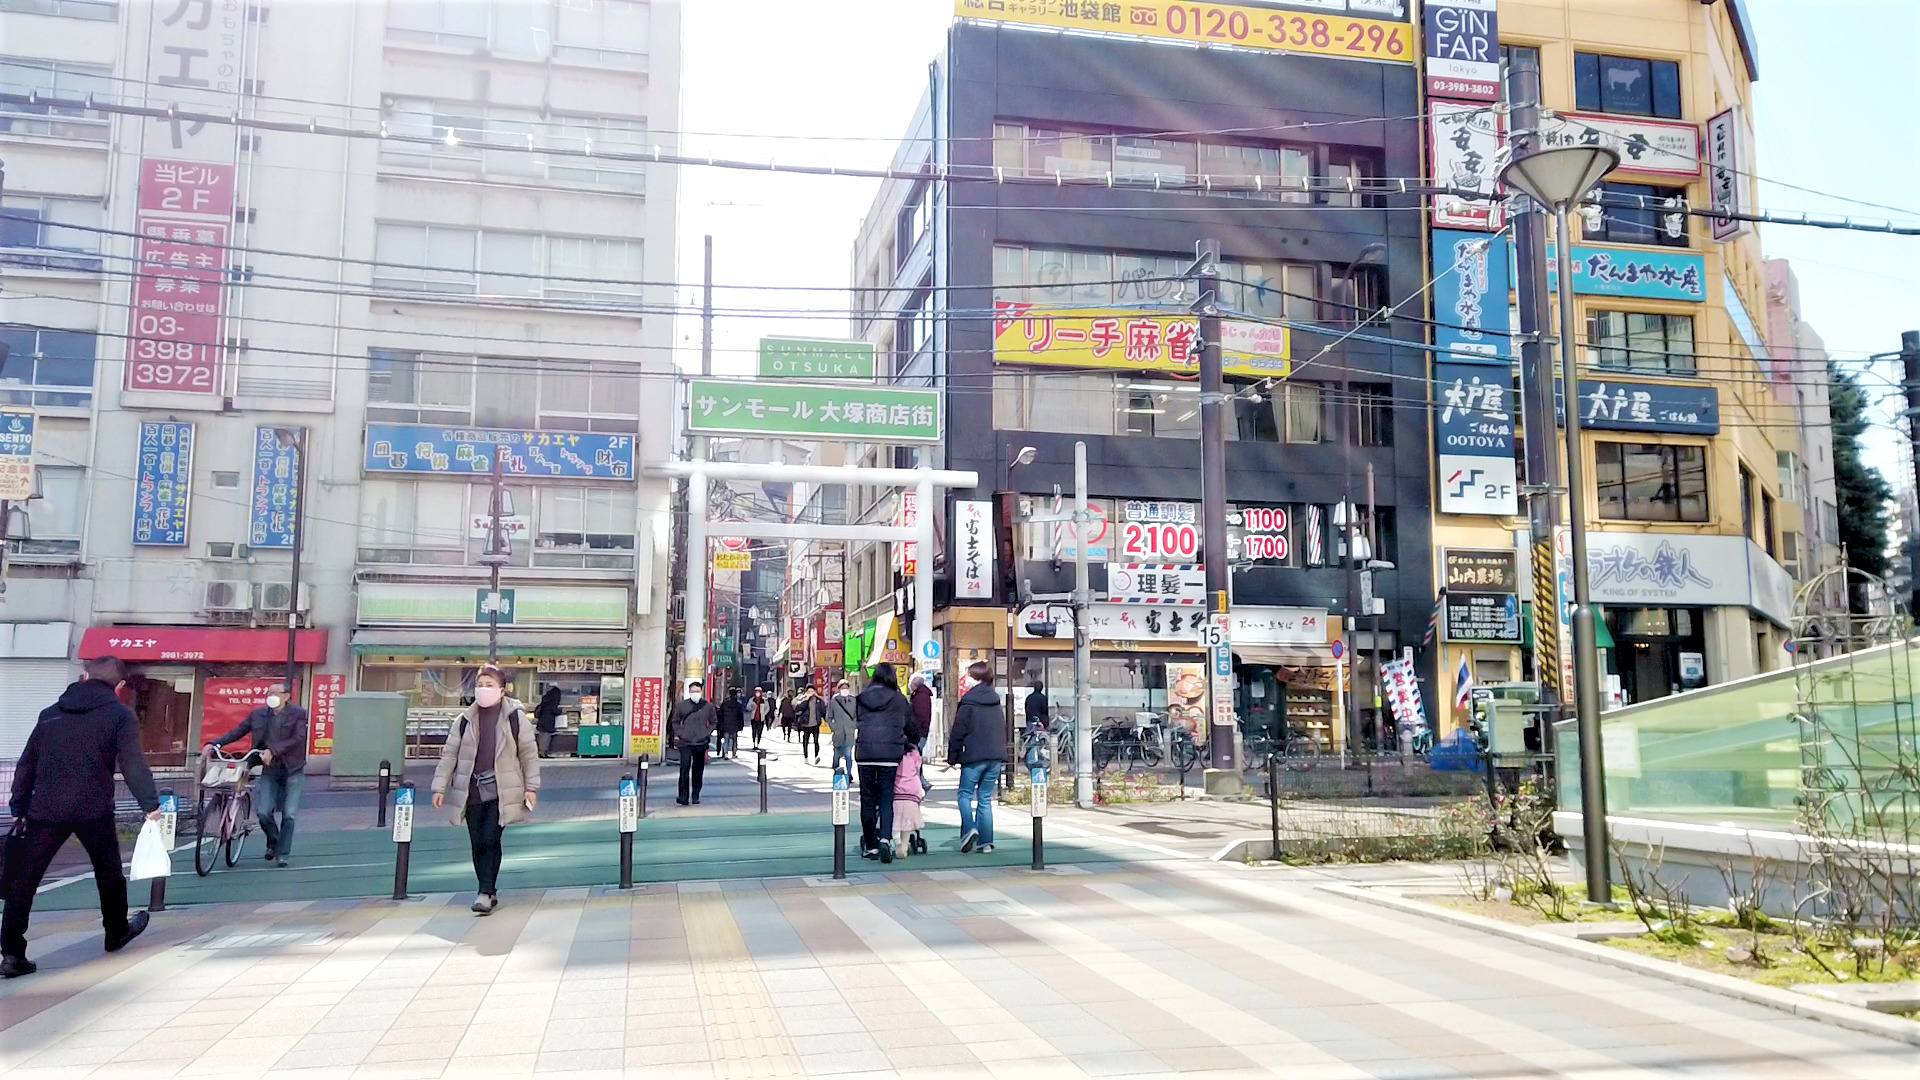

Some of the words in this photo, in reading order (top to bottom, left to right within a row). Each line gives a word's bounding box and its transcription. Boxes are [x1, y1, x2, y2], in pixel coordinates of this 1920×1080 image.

[1166, 5, 1404, 55] 0120-338-296
[1436, 36, 1489, 62] FAR
[1433, 80, 1494, 95] 03-3981-3802
[154, 164, 220, 186] 当ビル
[161, 187, 211, 211] 2F
[1588, 254, 1701, 294] だんまや水産
[140, 300, 217, 313] お問い合わせは
[139, 315, 185, 336] 03-
[137, 339, 206, 362] 3981
[766, 344, 866, 360] SUNMALL
[136, 363, 211, 386] 3972
[773, 360, 859, 376] OTSUKA
[1442, 376, 1509, 424] 大戸屋
[1588, 382, 1656, 425] 大戸屋
[696, 394, 814, 420] サンモール
[819, 400, 933, 427] 大塚商店街
[0, 432, 32, 443] SENTO
[608, 436, 628, 449] 2F
[1446, 434, 1506, 448] OOTOYA
[1484, 484, 1511, 499] 2F
[1126, 501, 1195, 522] 普通調髪
[165, 530, 184, 542] 2F
[1126, 525, 1196, 557] 2,100
[965, 519, 983, 580] 富士そば
[1137, 573, 1204, 595] 理髪一
[1448, 566, 1504, 585] 山内農場
[967, 581, 981, 590] 24
[1602, 588, 1626, 597] KING
[1627, 588, 1638, 597] OF
[1640, 588, 1678, 598] SYSTEM
[1029, 610, 1045, 620] 24
[1302, 616, 1316, 626] 24
[1200, 627, 1220, 645] 15
[1450, 628, 1464, 638] TEL
[108, 638, 158, 648] サカエヤ
